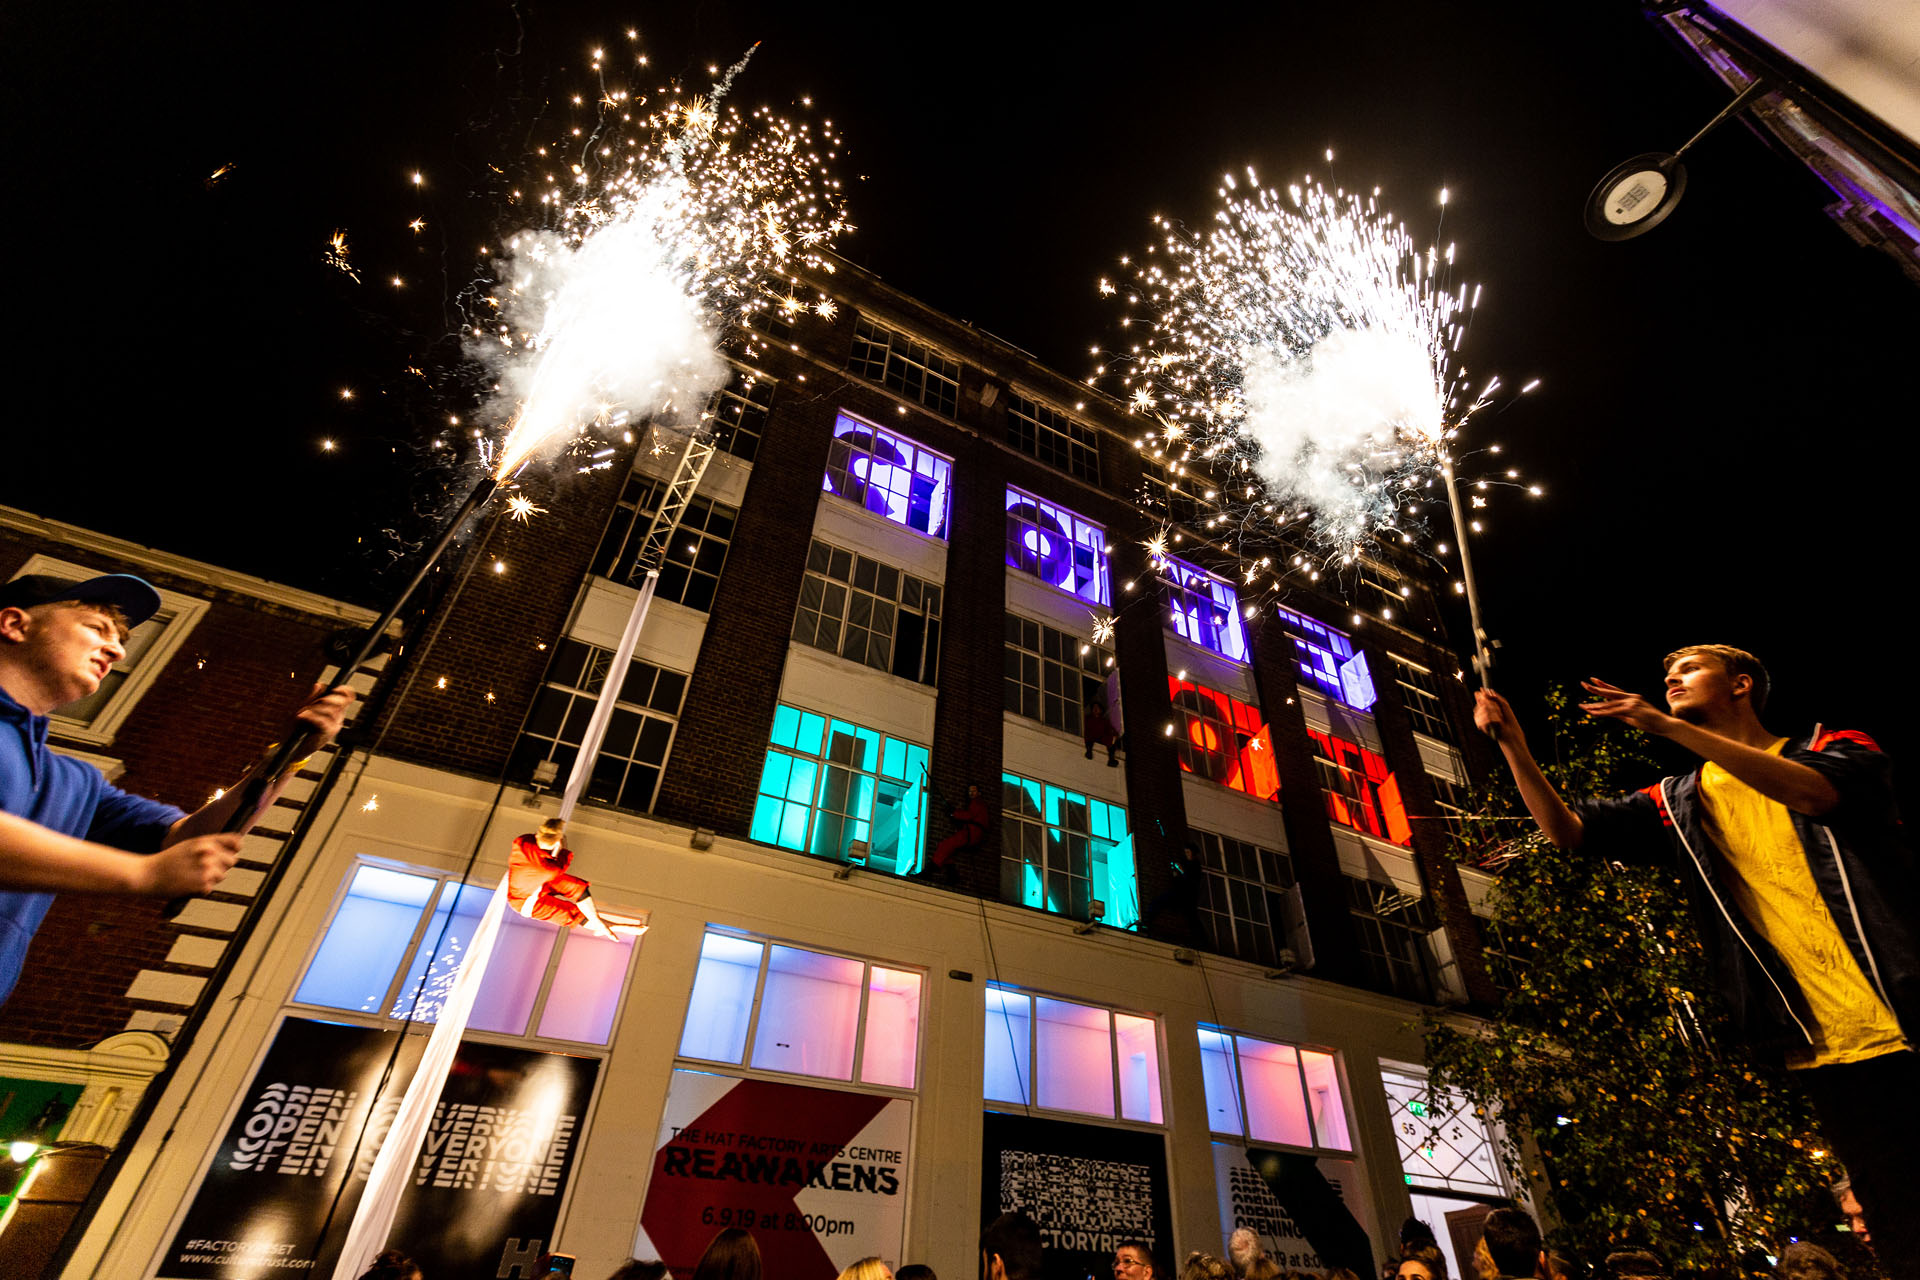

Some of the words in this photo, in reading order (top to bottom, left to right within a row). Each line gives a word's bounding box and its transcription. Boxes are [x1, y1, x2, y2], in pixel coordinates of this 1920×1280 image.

[1402, 1122, 1416, 1136] 65
[671, 1127, 700, 1143] THE
[704, 1130, 735, 1147] HAT
[739, 1134, 806, 1154] FACTORY
[809, 1142, 846, 1158] ARTS
[849, 1146, 902, 1164] CENTRE
[664, 1146, 899, 1196] REAWAKENS
[702, 1206, 756, 1228] 6.9.19
[760, 1212, 779, 1230] at
[784, 1213, 854, 1237] 8:00pm
[185, 1239, 296, 1256] #FACTORYSET
[179, 1254, 316, 1269] www.culttrust.com
